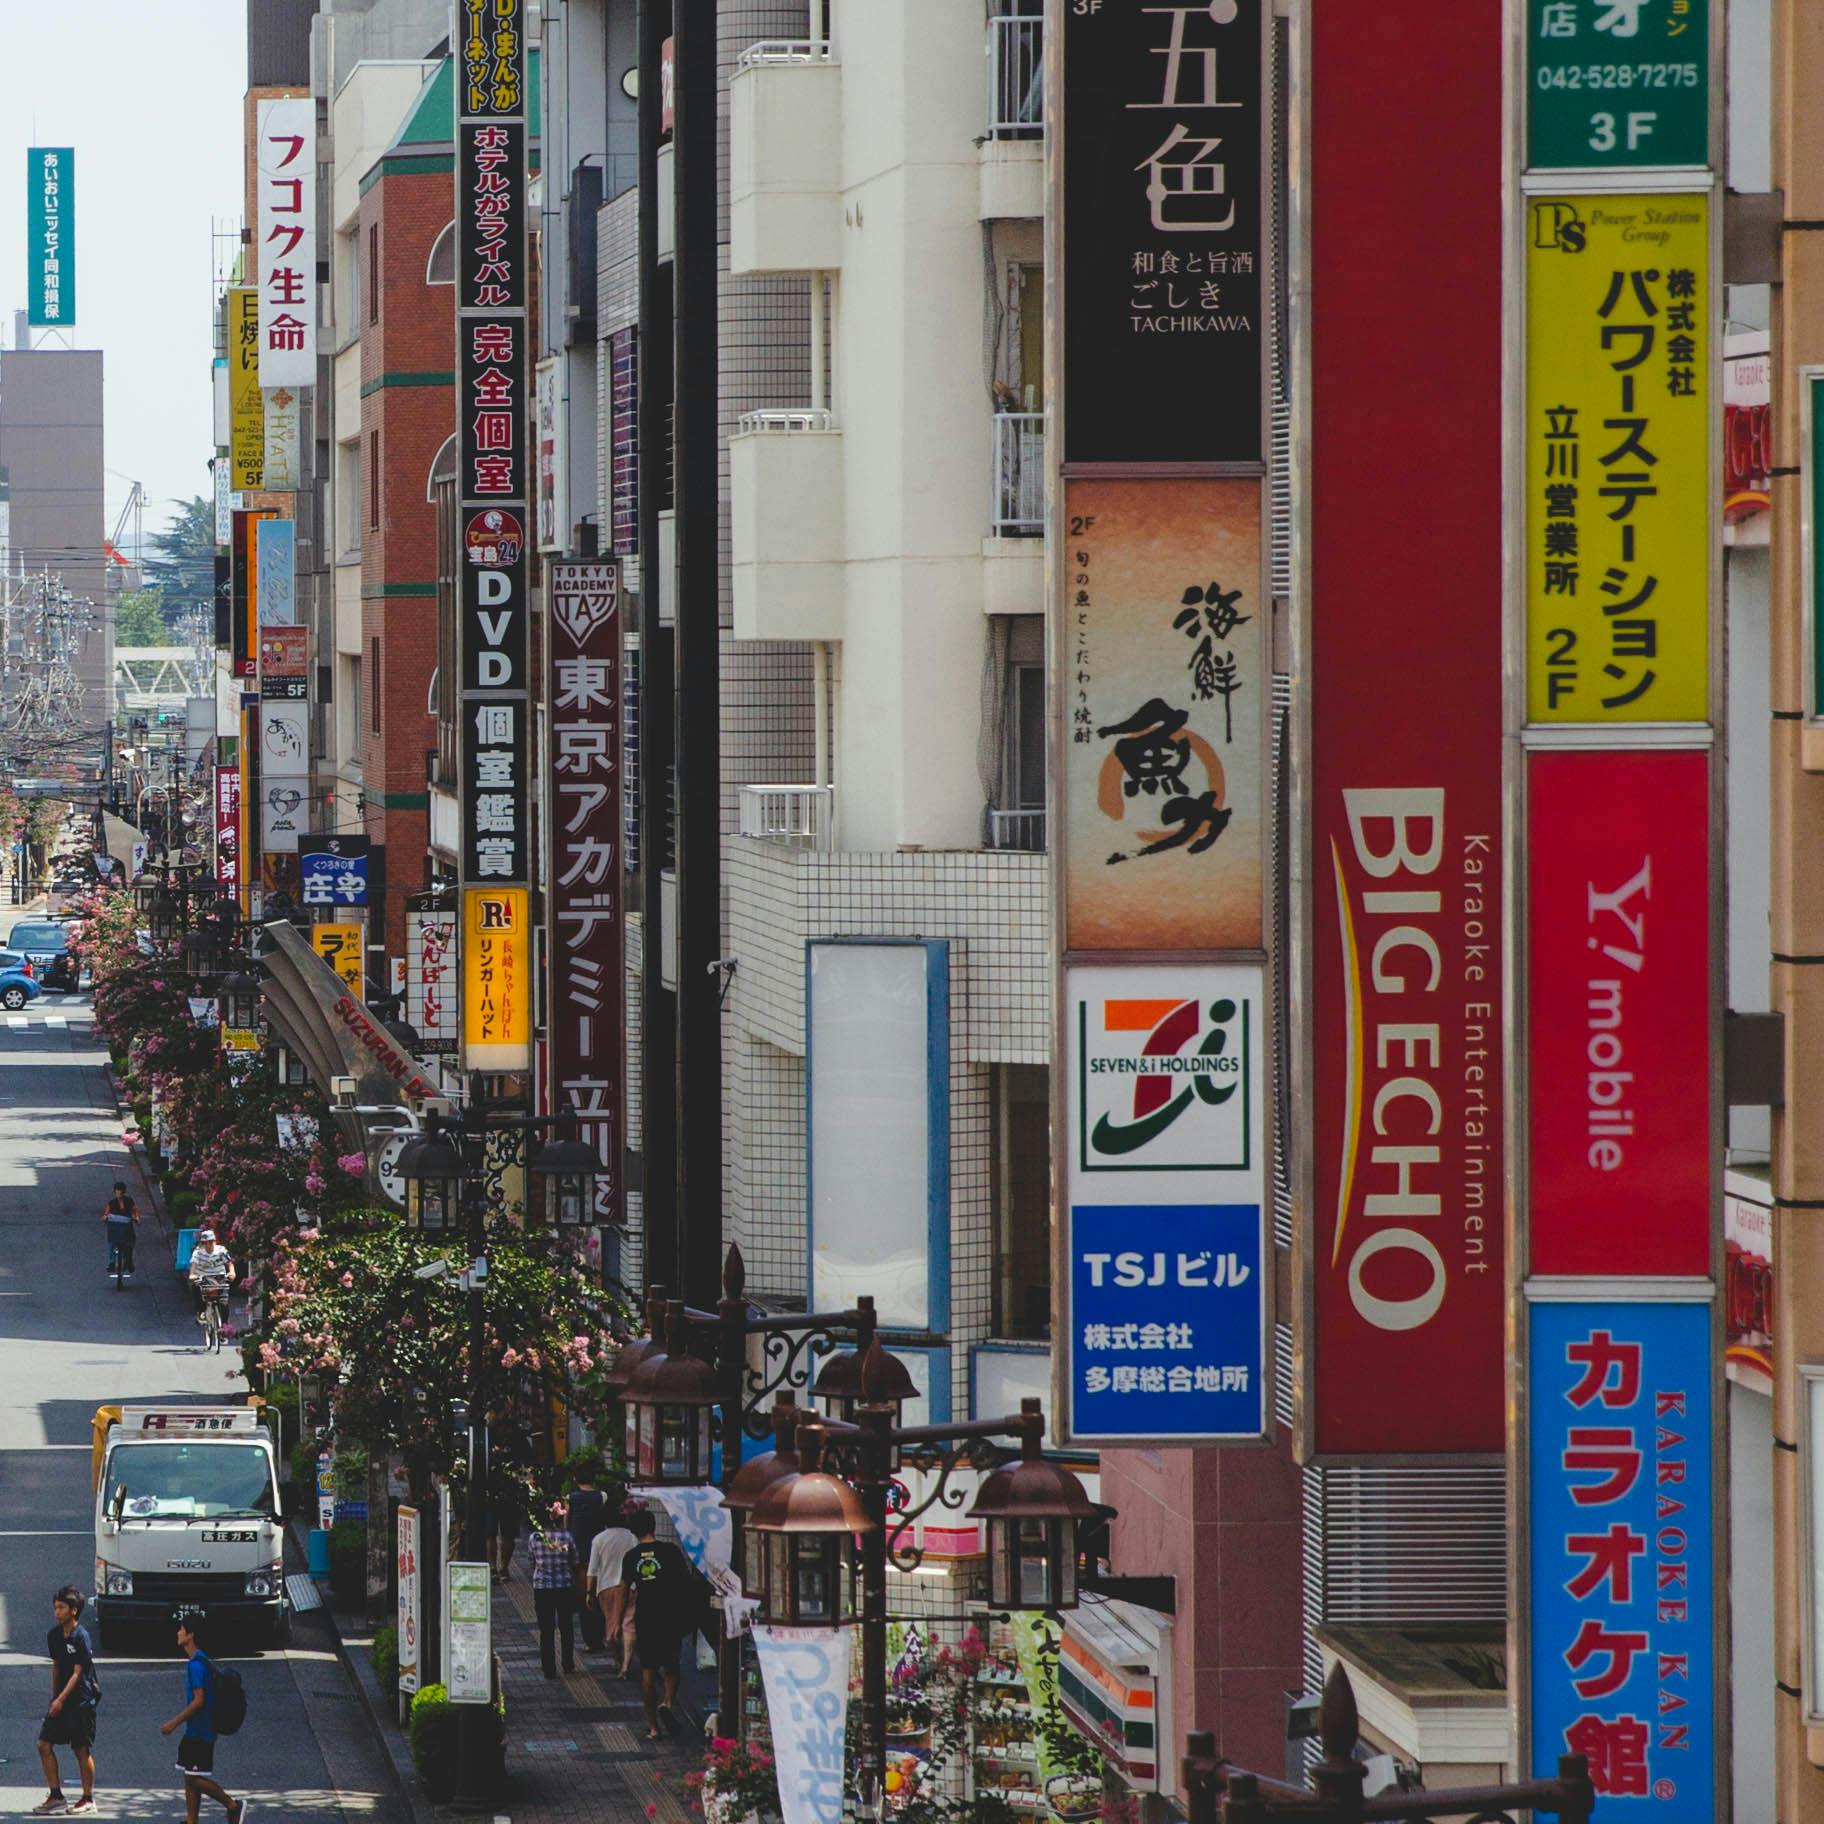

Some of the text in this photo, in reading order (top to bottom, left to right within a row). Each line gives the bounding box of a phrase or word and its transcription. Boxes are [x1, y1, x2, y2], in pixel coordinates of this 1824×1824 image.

[1588, 112, 1659, 153] 3F
[42, 152, 60, 320] あいおいニッセイ同和損保
[266, 134, 310, 352] フコク生命
[474, 126, 510, 307] ホテルがライバル
[1129, 249, 1254, 276] 和食と旨酒
[1129, 280, 1224, 311] ごしき
[1129, 315, 1252, 334] TACHIKAWA
[1665, 267, 1698, 399] 株式会社
[473, 324, 515, 494] 完全個室
[1070, 516, 1096, 537] 2F
[1543, 404, 1580, 711] 立川営業所 2F
[1596, 268, 1661, 711] パワーステーション
[477, 570, 513, 687] DVD
[553, 579, 616, 592] ACADEMY
[555, 566, 616, 578] TOKYO
[1171, 580, 1254, 745] 海鮮
[474, 705, 516, 878] 個室鑑賞
[552, 654, 615, 1056] 東京アカデミー
[479, 938, 495, 1040] リンガーハット
[1340, 786, 1448, 1333] BIG ECHO
[1463, 833, 1493, 1276] Karaoke Entertainment
[1585, 854, 1656, 1173] Y!mobile
[1158, 1056, 1240, 1075] HOLDINGS
[1083, 1251, 1251, 1289] TSJビル
[1083, 1323, 1194, 1351] 株式会社
[1083, 1364, 1250, 1394] 多摩総合地所
[1563, 1328, 1651, 1799] カラオケ館
[1655, 1389, 1690, 1751] KARAOKE KAN
